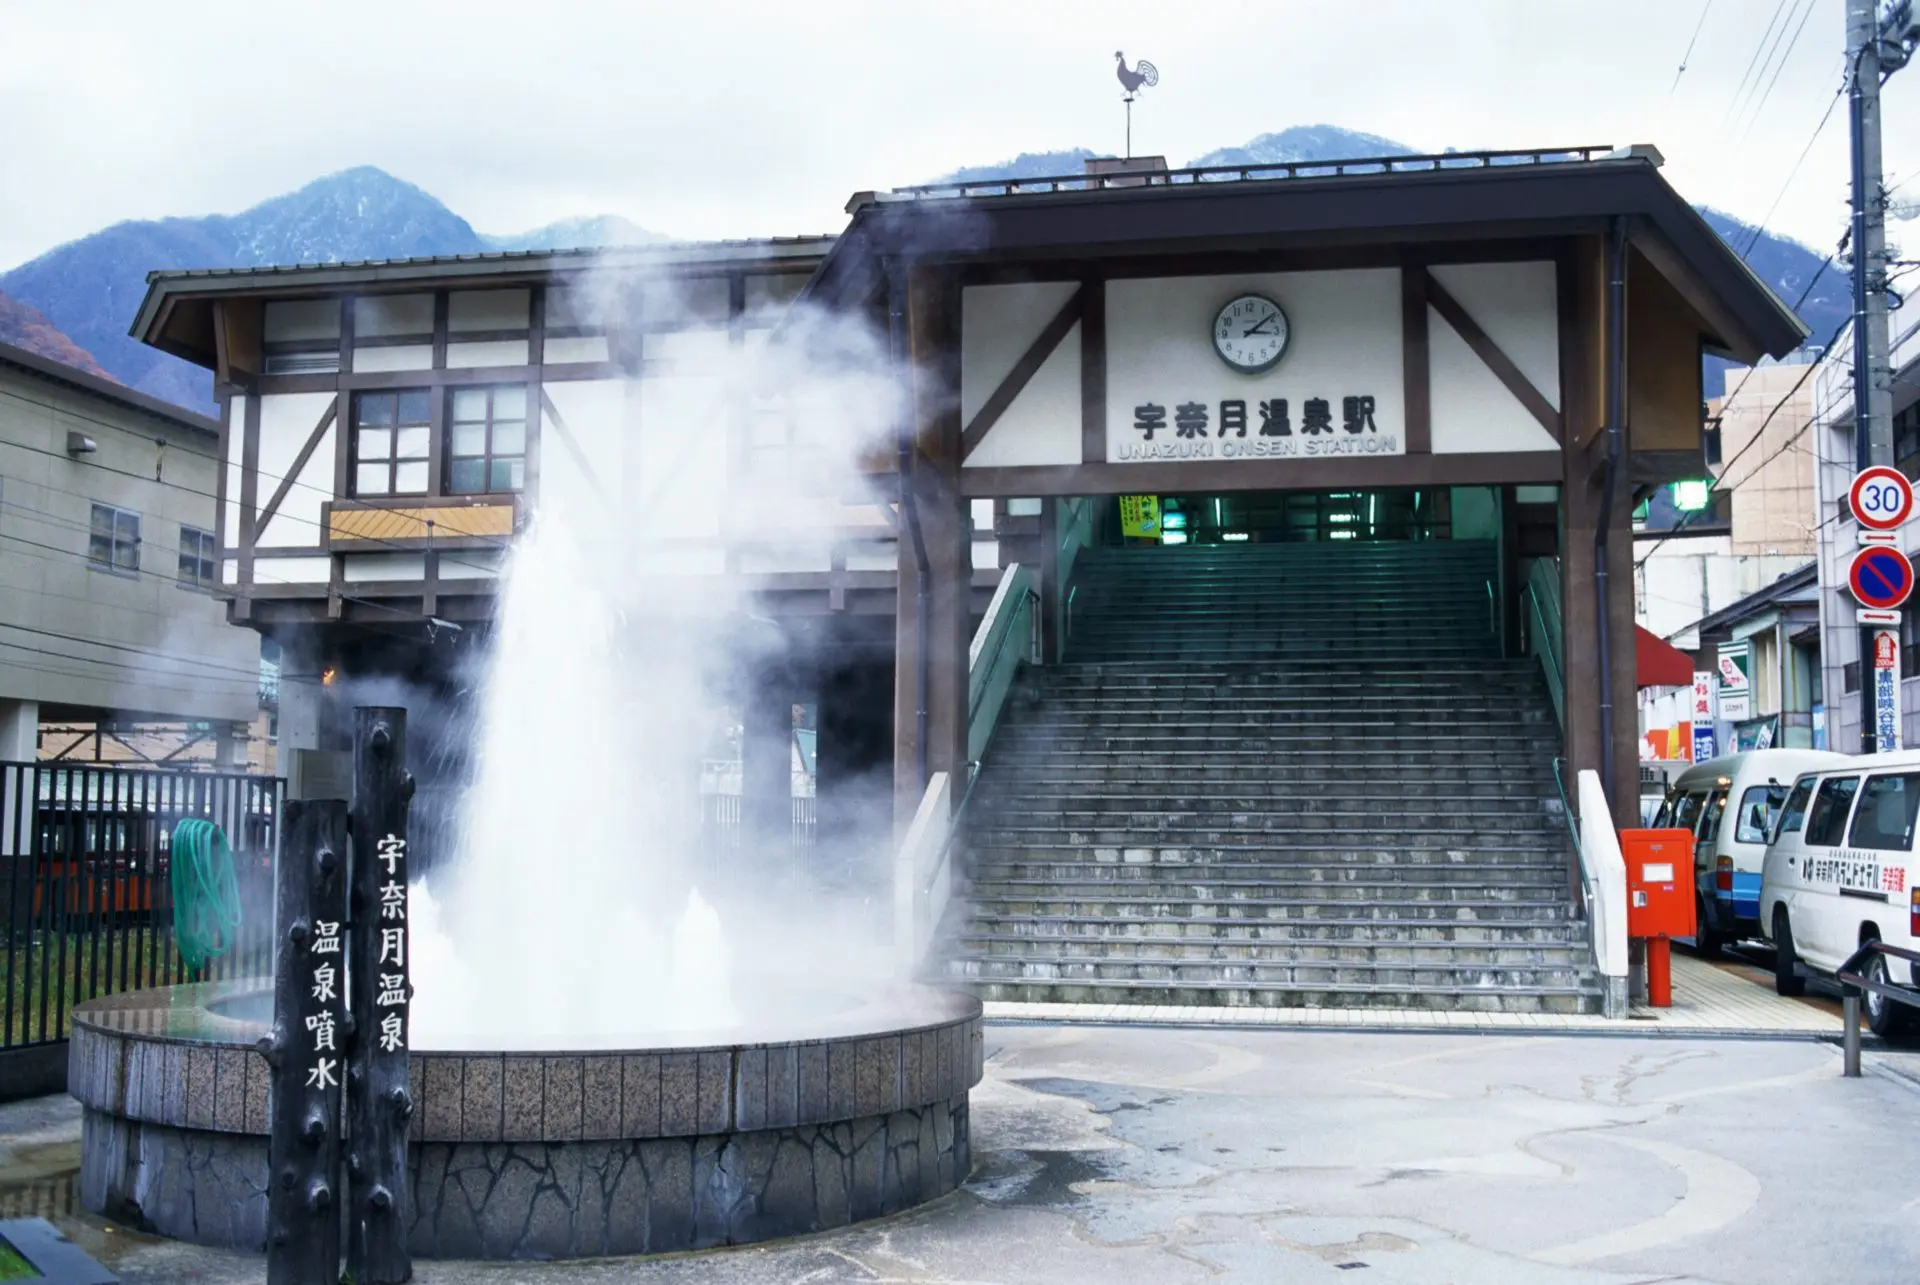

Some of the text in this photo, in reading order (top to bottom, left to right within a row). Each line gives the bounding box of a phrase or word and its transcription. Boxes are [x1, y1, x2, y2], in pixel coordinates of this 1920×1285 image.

[1233, 305, 1241, 317] 11
[1245, 302, 1254, 313] 12
[1223, 316, 1232, 327] 10
[1221, 328, 1228, 340] 9
[1273, 325, 1280, 336] 3
[1226, 342, 1232, 351] 8
[1269, 339, 1276, 349] 4
[1237, 350, 1242, 359] 7
[1248, 351, 1254, 362] 6
[1260, 348, 1267, 358] 5
[1133, 395, 1377, 441] 宇奈月温泉駅
[1118, 435, 1397, 461] UNAZUKI ONSEN STATION
[1864, 484, 1900, 512] 30
[376, 833, 407, 1053] 宇奈月温泉
[305, 919, 340, 1090] 温泉噴水
